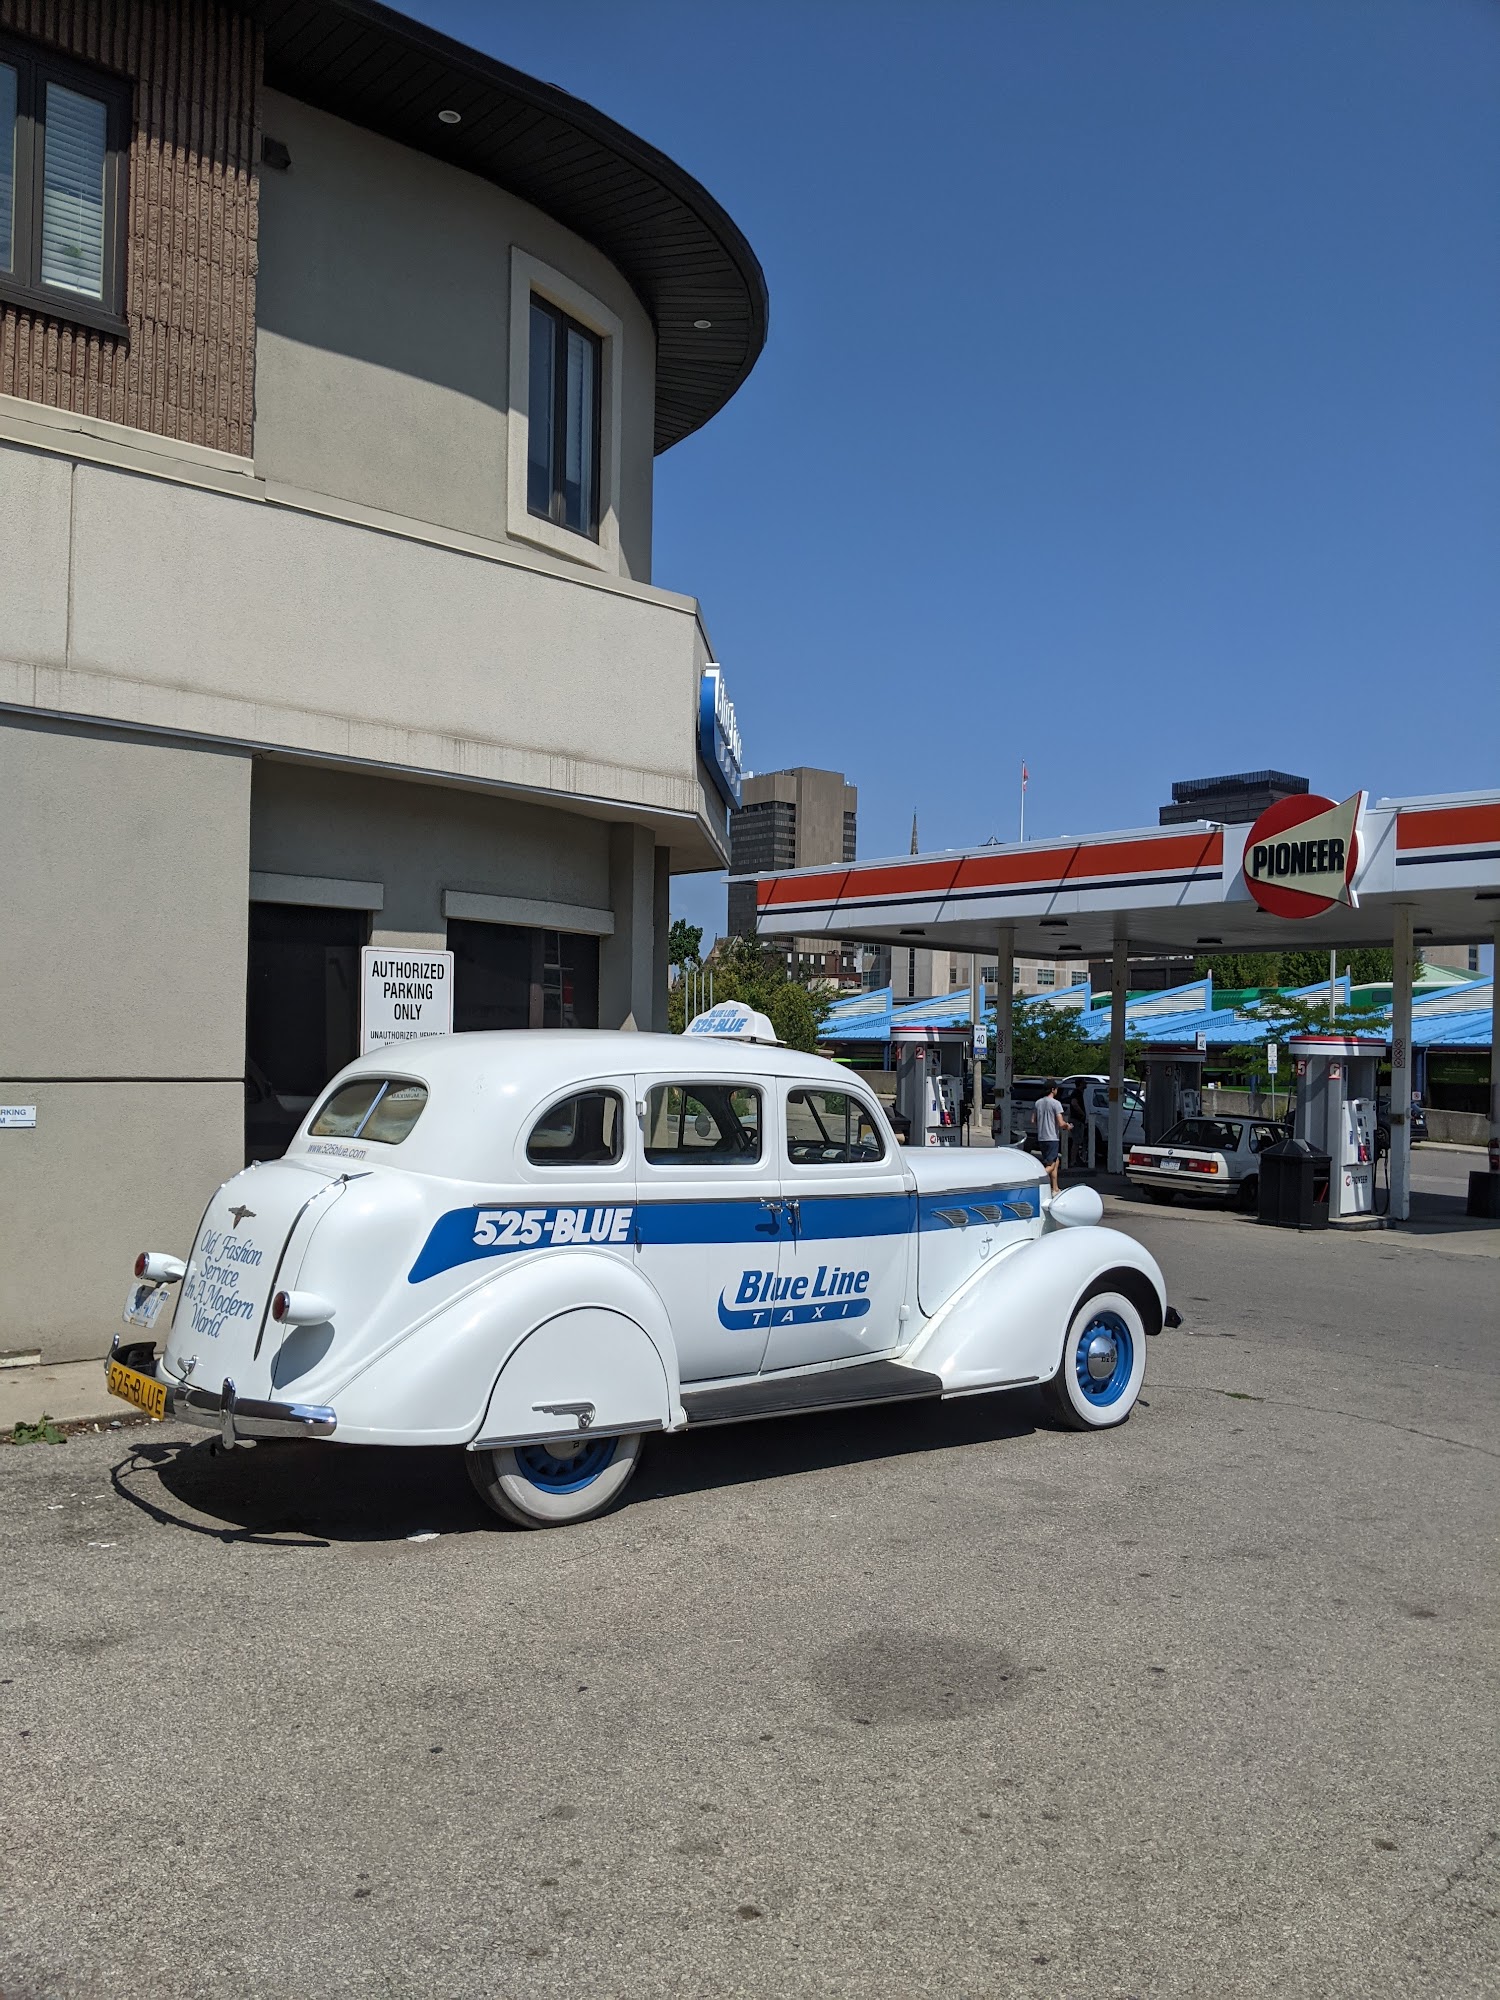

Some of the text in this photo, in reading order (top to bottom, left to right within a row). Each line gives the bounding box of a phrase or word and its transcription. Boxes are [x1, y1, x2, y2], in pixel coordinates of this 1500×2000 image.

[1253, 838, 1345, 877] PIONEER
[372, 961, 444, 979] AUTHORIZED
[383, 982, 433, 1000] PARKING
[394, 1003, 422, 1020] ONLY
[709, 1010, 739, 1018] BLUE LINE
[691, 1018, 748, 1033] 525-BLUE
[370, 1031, 418, 1040] UNAUTHORIZED
[976, 1034, 985, 1045] 40
[916, 1046, 924, 1058] 2
[1297, 1060, 1306, 1075] 5
[1330, 1063, 1340, 1078] 6
[308, 1143, 366, 1159] www.525blue.com
[472, 1208, 633, 1246] 525-BLUE
[201, 1229, 263, 1267] Old Fashion
[200, 1255, 240, 1288] Service
[735, 1265, 870, 1304] Blue Line
[184, 1275, 255, 1320] In A Modern
[191, 1303, 229, 1338] World
[752, 1303, 848, 1325] TAXI
[110, 1367, 164, 1416] 525-BLUE
